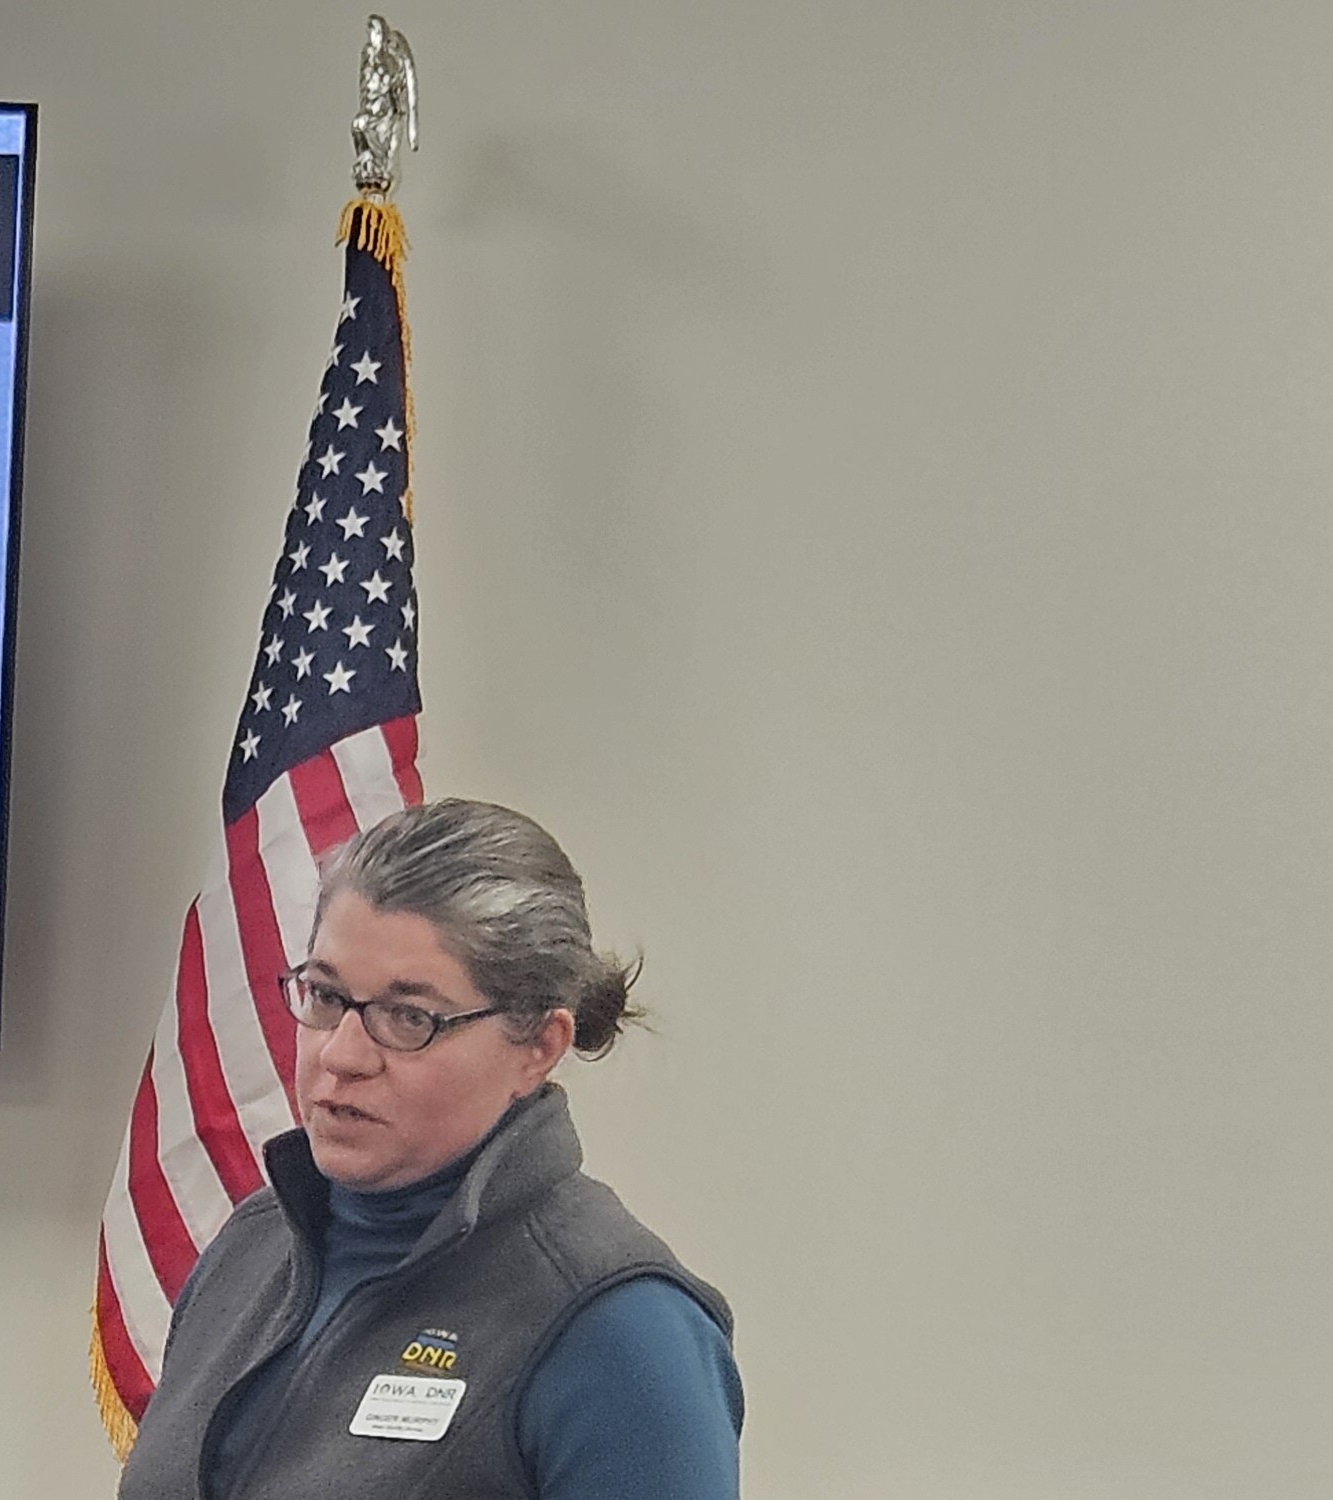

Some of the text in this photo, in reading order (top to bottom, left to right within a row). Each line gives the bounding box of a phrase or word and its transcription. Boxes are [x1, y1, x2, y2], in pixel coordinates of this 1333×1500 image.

[402, 1342, 456, 1368] DNR
[373, 1384, 457, 1399] IOWA DNR
